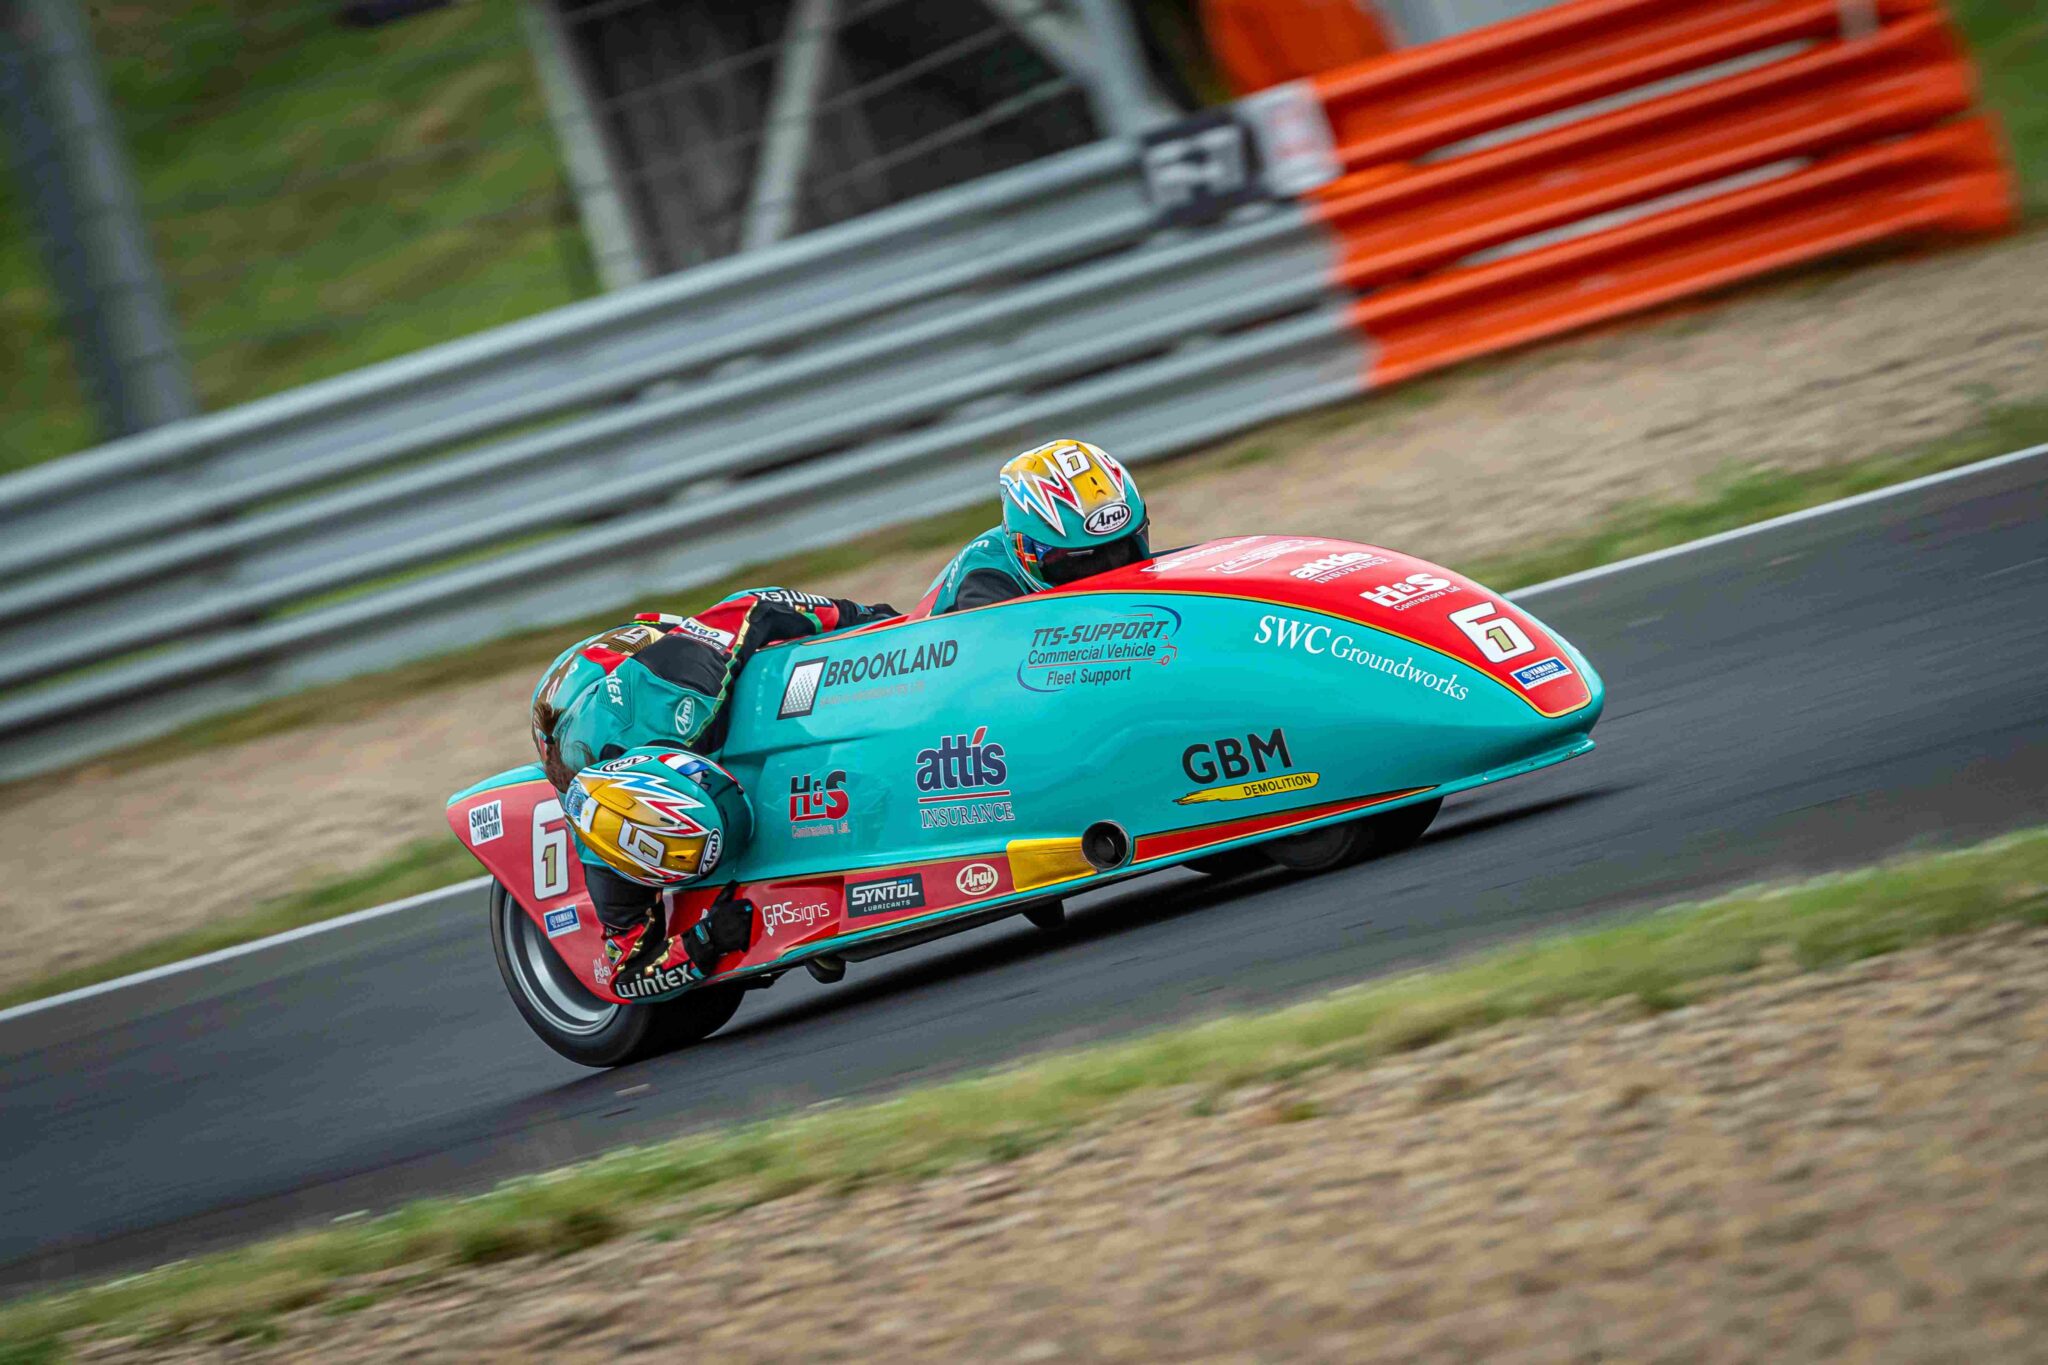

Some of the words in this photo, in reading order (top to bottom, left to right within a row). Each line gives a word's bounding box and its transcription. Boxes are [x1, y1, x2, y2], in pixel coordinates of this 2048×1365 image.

[1090, 506, 1126, 532] Arai
[1289, 552, 1374, 579] attis
[1314, 556, 1392, 584] INSURANCE
[754, 589, 832, 610] wintex
[1359, 573, 1451, 608] H&S
[1393, 590, 1446, 611] Contractors
[684, 621, 721, 638] GBM
[1031, 620, 1170, 647] TTS-SUPPORT
[823, 639, 959, 687] BROOKLAND
[1027, 644, 1103, 665] Commercial
[1107, 642, 1156, 659] Vehicle
[1253, 614, 1332, 655] SWC
[1330, 635, 1469, 701] Groundworks
[1046, 668, 1077, 686] Fleet
[1080, 665, 1132, 687] Support
[678, 697, 694, 734] Arai
[916, 726, 1008, 792] attis
[1181, 728, 1294, 785] GBM
[789, 769, 850, 822] H&S
[1243, 774, 1313, 797] DEMOLITION
[470, 803, 500, 828] SHOCK
[919, 801, 1016, 829] INSURANCE
[479, 821, 501, 841] FACTORY
[701, 829, 720, 875] Arai
[959, 867, 994, 890] Arai
[851, 879, 919, 906] SYNTOL
[863, 899, 911, 913] LUBRICANTS
[615, 964, 695, 998] wintex
